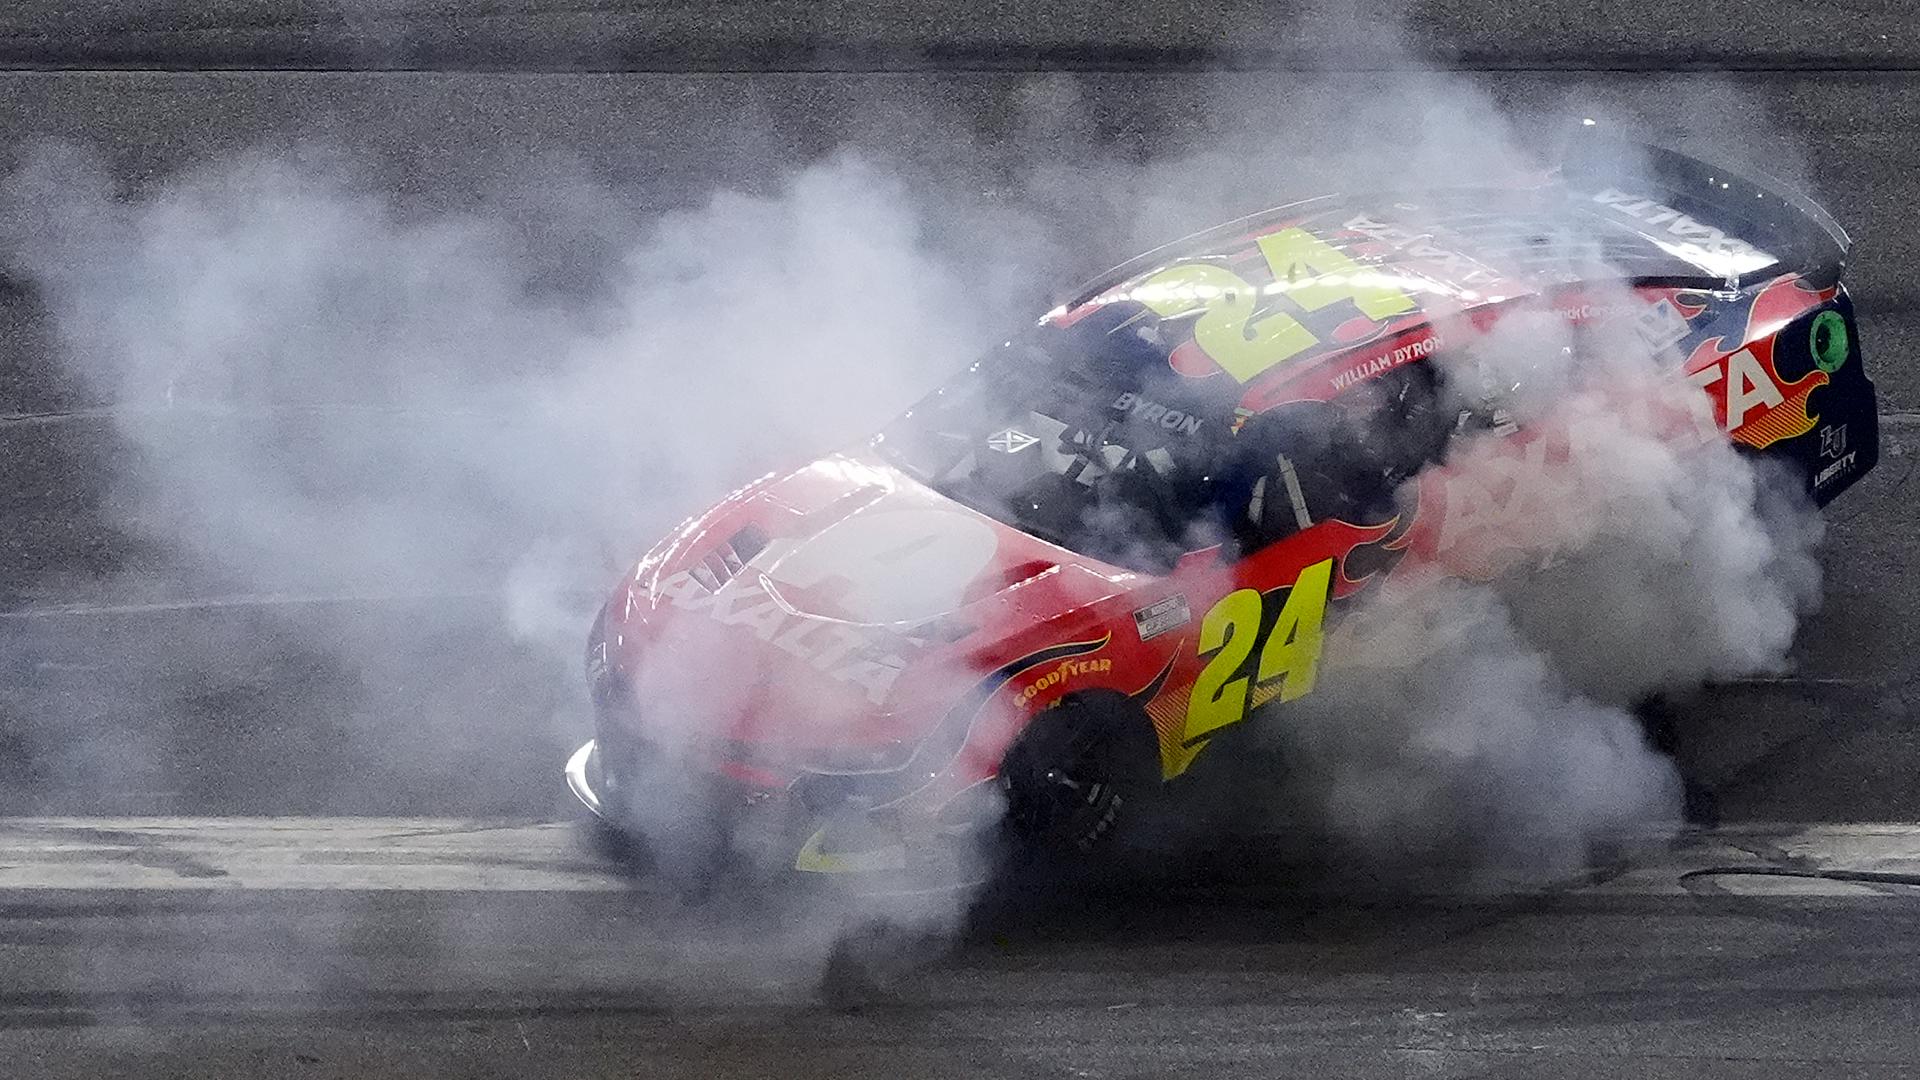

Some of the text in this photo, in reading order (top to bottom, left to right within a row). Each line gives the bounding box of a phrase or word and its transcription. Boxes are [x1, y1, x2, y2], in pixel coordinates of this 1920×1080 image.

[1132, 226, 1416, 384] 24
[1330, 337, 1441, 390] WILLIAM BYRON
[1113, 392, 1203, 435] BYRON
[1815, 451, 1856, 487] LIBERTY
[1184, 558, 1333, 742] 24
